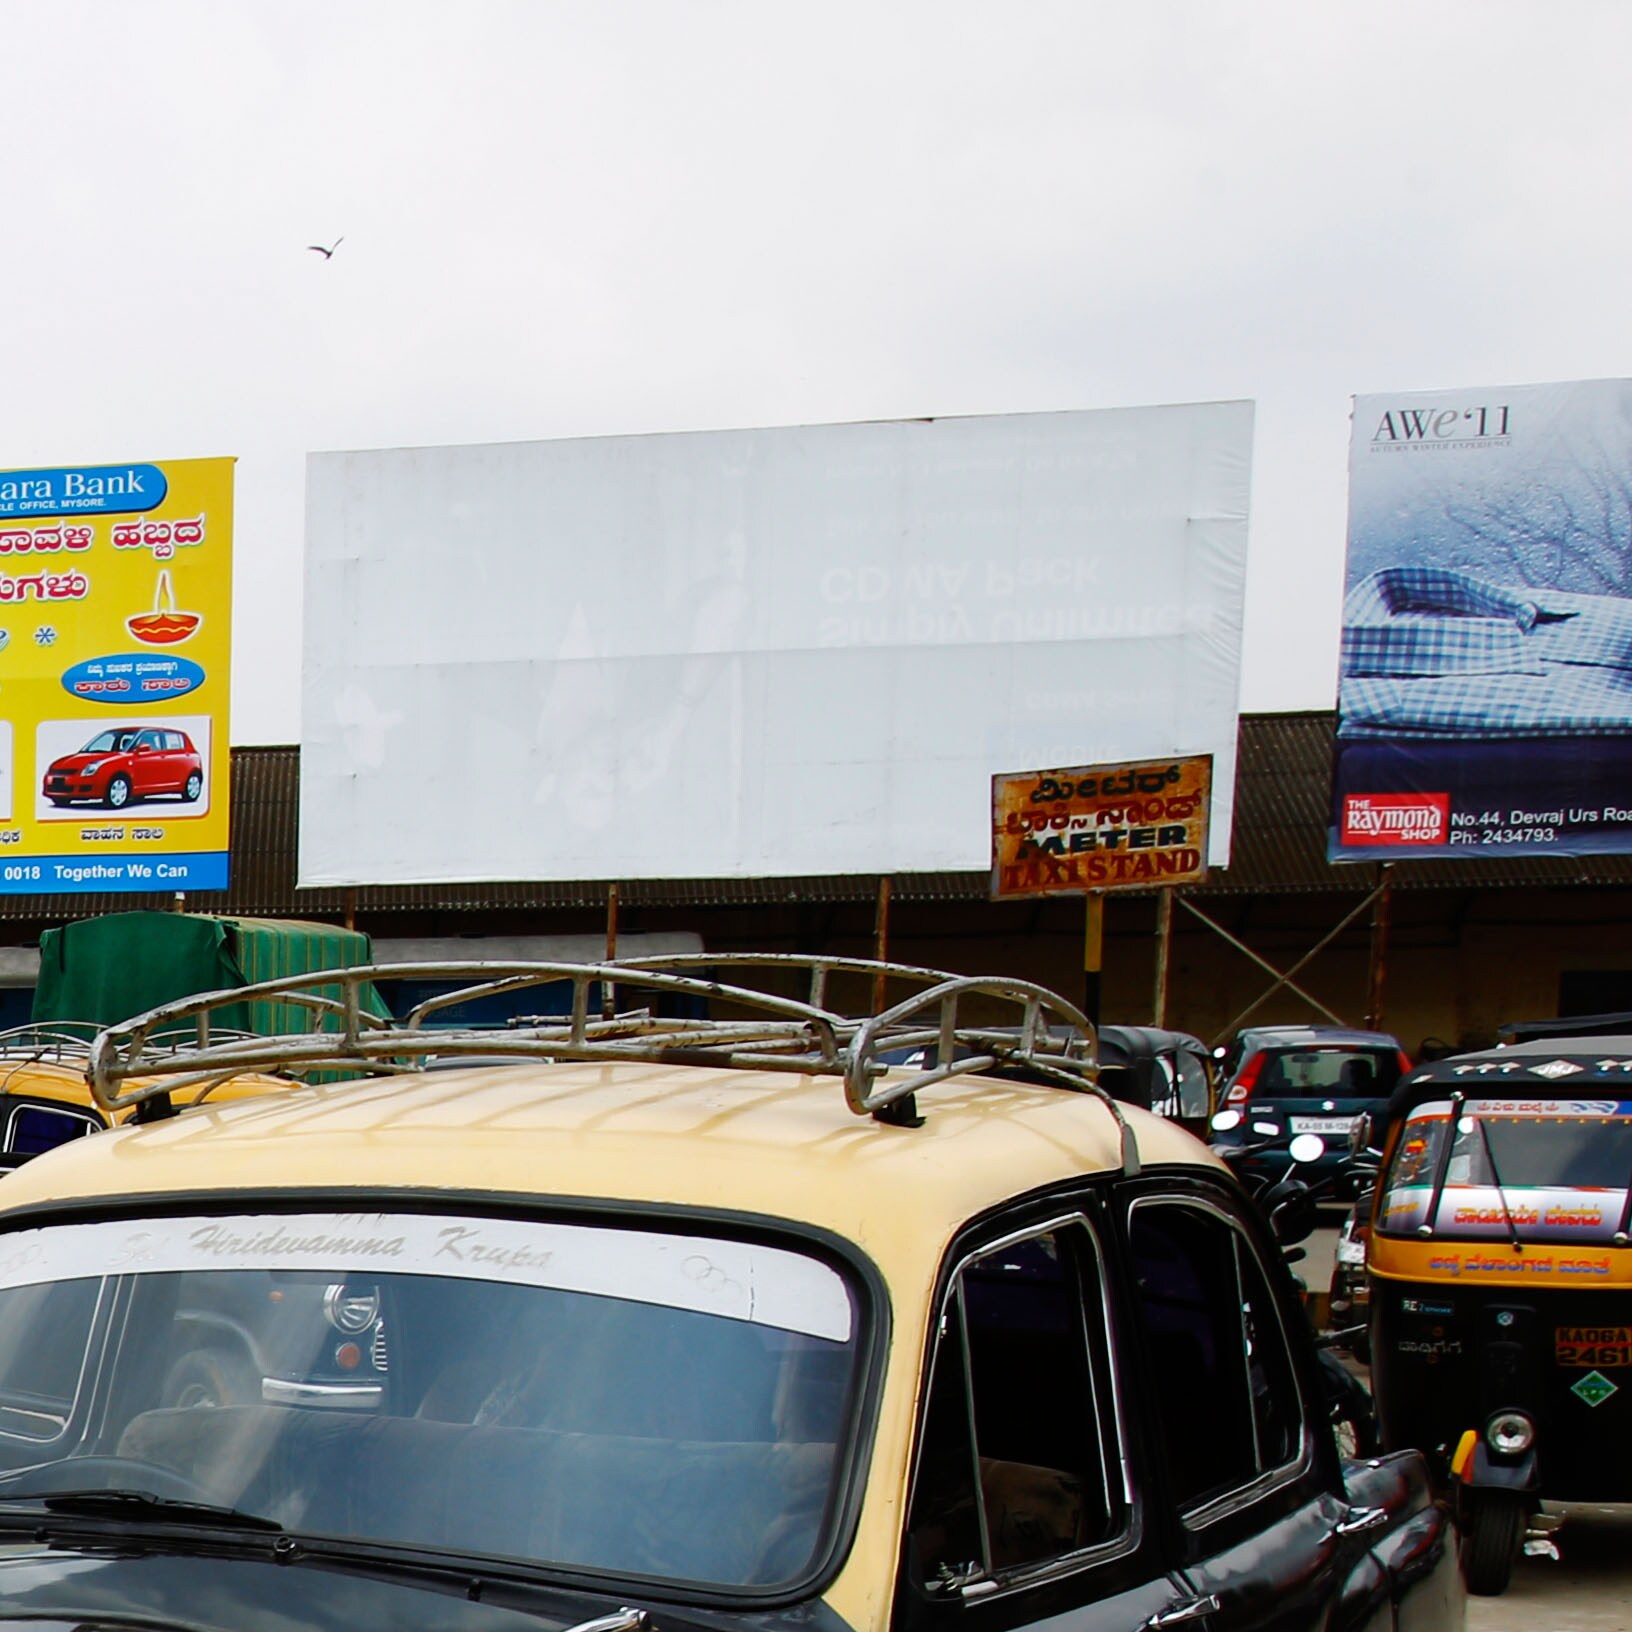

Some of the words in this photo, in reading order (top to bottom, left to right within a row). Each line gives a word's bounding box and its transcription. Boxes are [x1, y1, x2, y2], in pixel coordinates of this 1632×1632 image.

[63, 470, 145, 497] Bank
[112, 515, 205, 557] ಹಬ್ಬದ
[1031, 764, 1180, 804] ಮೀಟರ್
[1348, 800, 1371, 810] THE
[1451, 812, 1505, 828] No.44,
[1510, 809, 1564, 826] Devraj
[1569, 808, 1598, 823] Urs
[1348, 806, 1442, 835] Raymond
[1016, 825, 1187, 860] METER
[1401, 829, 1440, 840] SHOP
[1450, 831, 1478, 844] Ph:
[1483, 828, 1558, 843] 2434793.
[5, 864, 40, 880] 0018
[54, 863, 124, 881] Together
[126, 863, 152, 878] We
[157, 862, 188, 878] Can
[1005, 859, 1083, 889] TAXI
[1086, 849, 1201, 881] STAND
